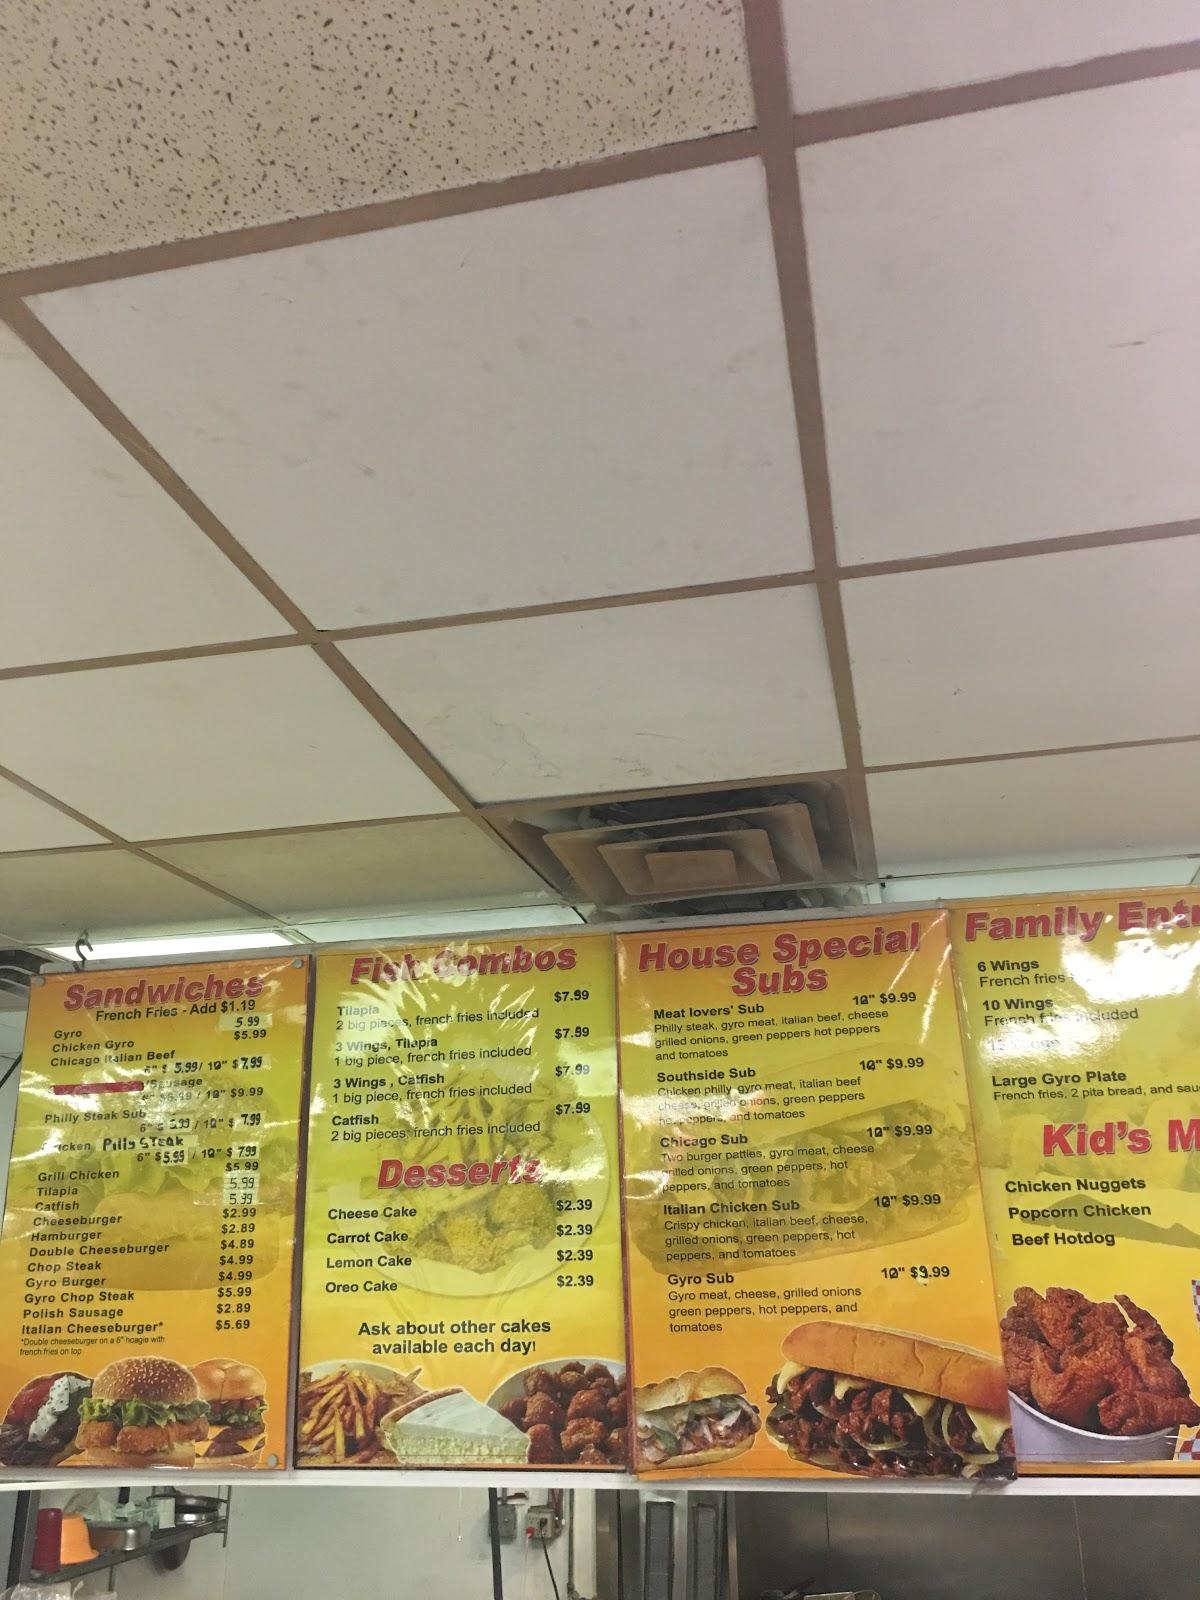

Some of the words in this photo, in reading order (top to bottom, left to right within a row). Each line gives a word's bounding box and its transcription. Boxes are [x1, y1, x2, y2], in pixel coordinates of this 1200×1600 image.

[965, 905, 1105, 942] Family
[639, 940, 760, 972] House
[772, 921, 921, 968] Special
[977, 961, 987, 972] 6
[990, 959, 1040, 973] Wings
[732, 963, 829, 996] Subs
[979, 976, 1030, 987] French
[1034, 973, 1066, 985] fries
[64, 974, 264, 1011] Sandwiches
[880, 992, 916, 1004] $9.99
[96, 1009, 142, 1021] French
[146, 1006, 177, 1018] Fries
[190, 1003, 216, 1015] Add
[221, 1000, 255, 1013] $1.19
[337, 1005, 379, 1016] Tilapia
[654, 1006, 686, 1019] Meat
[738, 1003, 765, 1015] Sub
[982, 999, 1001, 1011] 10
[1004, 997, 1054, 1011] Wings
[457, 1011, 482, 1022] fries
[848, 1009, 889, 1020] cheese
[54, 1029, 82, 1040] Gyro
[234, 1029, 267, 1041] $5.99
[732, 1031, 763, 1044] green
[766, 1028, 810, 1042] peppers
[835, 1024, 881, 1037] peppers
[52, 1042, 100, 1052] Chicken
[105, 1039, 134, 1050] Gyro
[346, 1039, 391, 1053] Wings,
[395, 1037, 438, 1050] Tilapia
[450, 1047, 475, 1059] fries
[479, 1045, 532, 1058] included
[50, 1055, 99, 1067] Chicago
[147, 1051, 175, 1061] Beef
[679, 1047, 729, 1060] tomatoes
[887, 1057, 924, 1069] $9.99
[657, 1068, 725, 1082] Southside
[729, 1066, 756, 1079] Sub
[992, 1074, 1037, 1088] Large
[1042, 1072, 1081, 1087] Gyro
[1086, 1070, 1127, 1082] Plate
[345, 1076, 386, 1090] Wings
[398, 1073, 444, 1086] Catfish
[836, 1076, 861, 1087] beef
[230, 1087, 263, 1098] $9.99
[449, 1084, 476, 1097] fries
[479, 1083, 532, 1096] included
[993, 1090, 1035, 1101] French
[1037, 1088, 1068, 1100] fries,
[1082, 1087, 1104, 1099] pita
[1107, 1085, 1147, 1097] bread,
[1150, 1084, 1173, 1094] and
[783, 1095, 815, 1107] green
[818, 1091, 865, 1104] peppers
[332, 1114, 379, 1126] Catfish
[753, 1109, 805, 1122] tomatoes
[413, 1124, 452, 1137] french
[457, 1122, 483, 1135] fries
[487, 1121, 540, 1134] included
[894, 1124, 933, 1137] $9.99
[660, 1134, 717, 1149] Chicago
[720, 1133, 748, 1146] Sub
[1043, 1121, 1152, 1157] Kid's
[686, 1151, 722, 1164] burger
[833, 1143, 874, 1155] cheese
[38, 1171, 66, 1182] Grill
[69, 1169, 120, 1180] Chicken
[378, 1154, 544, 1189] Desserts
[740, 1164, 773, 1176] green
[776, 1161, 827, 1175] peppers,
[738, 1177, 791, 1190] tomatoes
[1005, 1179, 1071, 1193] Chicken
[1076, 1177, 1146, 1193] Nuggets
[37, 1186, 79, 1198] Tilapia
[35, 1201, 80, 1212] Catfish
[556, 1199, 592, 1212] $2.39
[902, 1193, 942, 1207] $9.99
[222, 1207, 256, 1219] $2.99
[328, 1208, 378, 1220] Cheese
[383, 1206, 417, 1218] Cake
[663, 1203, 706, 1216] Italian
[710, 1200, 768, 1214] Chicken
[771, 1200, 800, 1212] Sub
[1008, 1207, 1078, 1221] Popcorn
[1083, 1204, 1152, 1217] Chicken
[33, 1214, 122, 1227] Cheeseburger
[664, 1220, 700, 1234] Crispy
[703, 1217, 750, 1230] chicken,
[752, 1216, 787, 1228] italian
[822, 1213, 868, 1225] cheese,
[221, 1223, 255, 1235] $2.89
[556, 1224, 593, 1236] $2.39
[31, 1231, 102, 1243] Hamburger
[327, 1232, 370, 1244] Carrot
[374, 1230, 408, 1243] Cake
[665, 1234, 699, 1248] grilled
[746, 1233, 781, 1245] green
[783, 1230, 834, 1244] peppers,
[1012, 1233, 1049, 1246] Beef
[1054, 1231, 1116, 1247] Hotdog
[29, 1246, 75, 1257] Double
[79, 1243, 169, 1256] Cheeseburger
[556, 1250, 593, 1262] $2.39
[666, 1250, 716, 1264] peppers,
[743, 1246, 796, 1259] tomatoes
[27, 1262, 61, 1275] Chop
[66, 1260, 102, 1271] Steak
[219, 1255, 253, 1266] $4.99
[326, 1257, 373, 1269] Lemon
[377, 1255, 412, 1267] Cake
[25, 1277, 57, 1289] Gyro
[62, 1276, 106, 1288] Burger
[218, 1271, 252, 1282] $4.99
[557, 1275, 594, 1287] $2.39
[667, 1274, 702, 1289] Gyro
[706, 1273, 735, 1285] Sub
[217, 1287, 252, 1298] $5.99
[325, 1281, 359, 1293] Oreo
[363, 1280, 397, 1292] Cake
[24, 1293, 55, 1305] Gyro
[60, 1291, 94, 1304] Chop
[99, 1290, 135, 1302] Steak
[668, 1290, 696, 1304] Gyro
[734, 1287, 780, 1300] cheese,
[783, 1286, 819, 1300] grilled
[821, 1286, 862, 1297] onions
[23, 1308, 64, 1319] Polish
[69, 1307, 124, 1319] Sausage
[669, 1306, 702, 1319] green
[705, 1304, 756, 1318] peppers,
[780, 1302, 832, 1316] peppers,
[22, 1324, 62, 1335] Italian
[215, 1319, 250, 1331] $5.69
[358, 1321, 390, 1335] Ask
[396, 1320, 445, 1334] about
[450, 1320, 495, 1333] other
[501, 1319, 551, 1333] cakes
[669, 1320, 723, 1333] tomatoes
[51, 1337, 97, 1346] cheeseburger
[126, 1336, 149, 1345] hoagie
[151, 1335, 165, 1344] with
[373, 1340, 448, 1354] available
[453, 1340, 495, 1353] each
[20, 1347, 41, 1356] french
